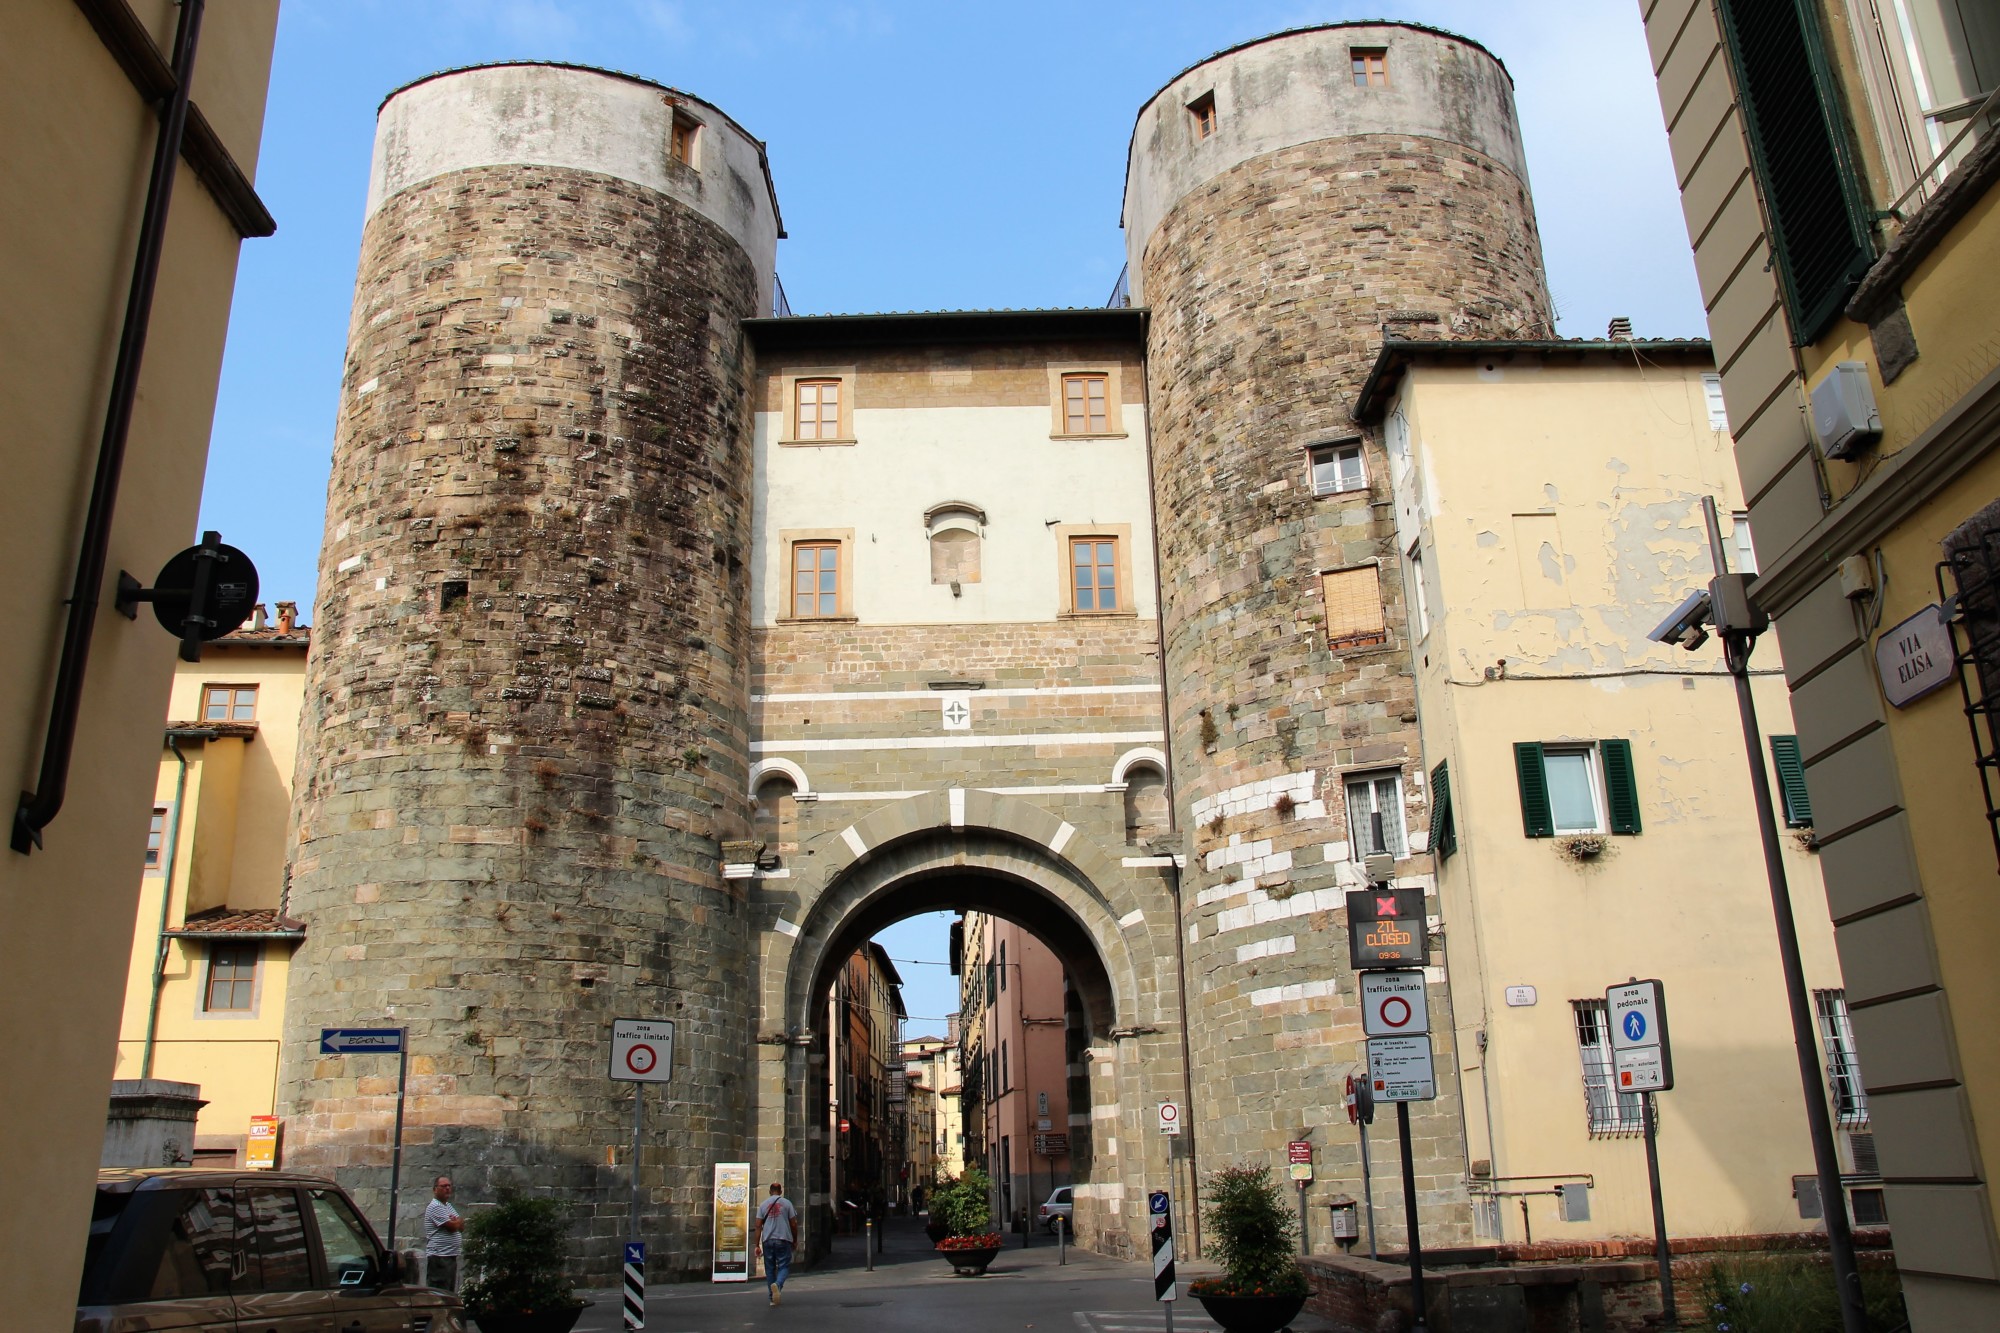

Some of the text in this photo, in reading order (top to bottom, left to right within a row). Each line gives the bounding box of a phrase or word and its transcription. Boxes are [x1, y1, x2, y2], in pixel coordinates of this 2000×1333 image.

[1899, 633, 1922, 658] VIA
[1897, 651, 1934, 684] ELISA
[1376, 920, 1399, 933] ZTL
[1366, 932, 1411, 946] CLOSED
[1378, 951, 1401, 959] 09:36
[1366, 983, 1421, 993] traffico limitato
[1623, 989, 1639, 997] area
[1617, 997, 1648, 1009] pedonale
[644, 1033, 670, 1041] limitato
[251, 1127, 268, 1135] LAM
